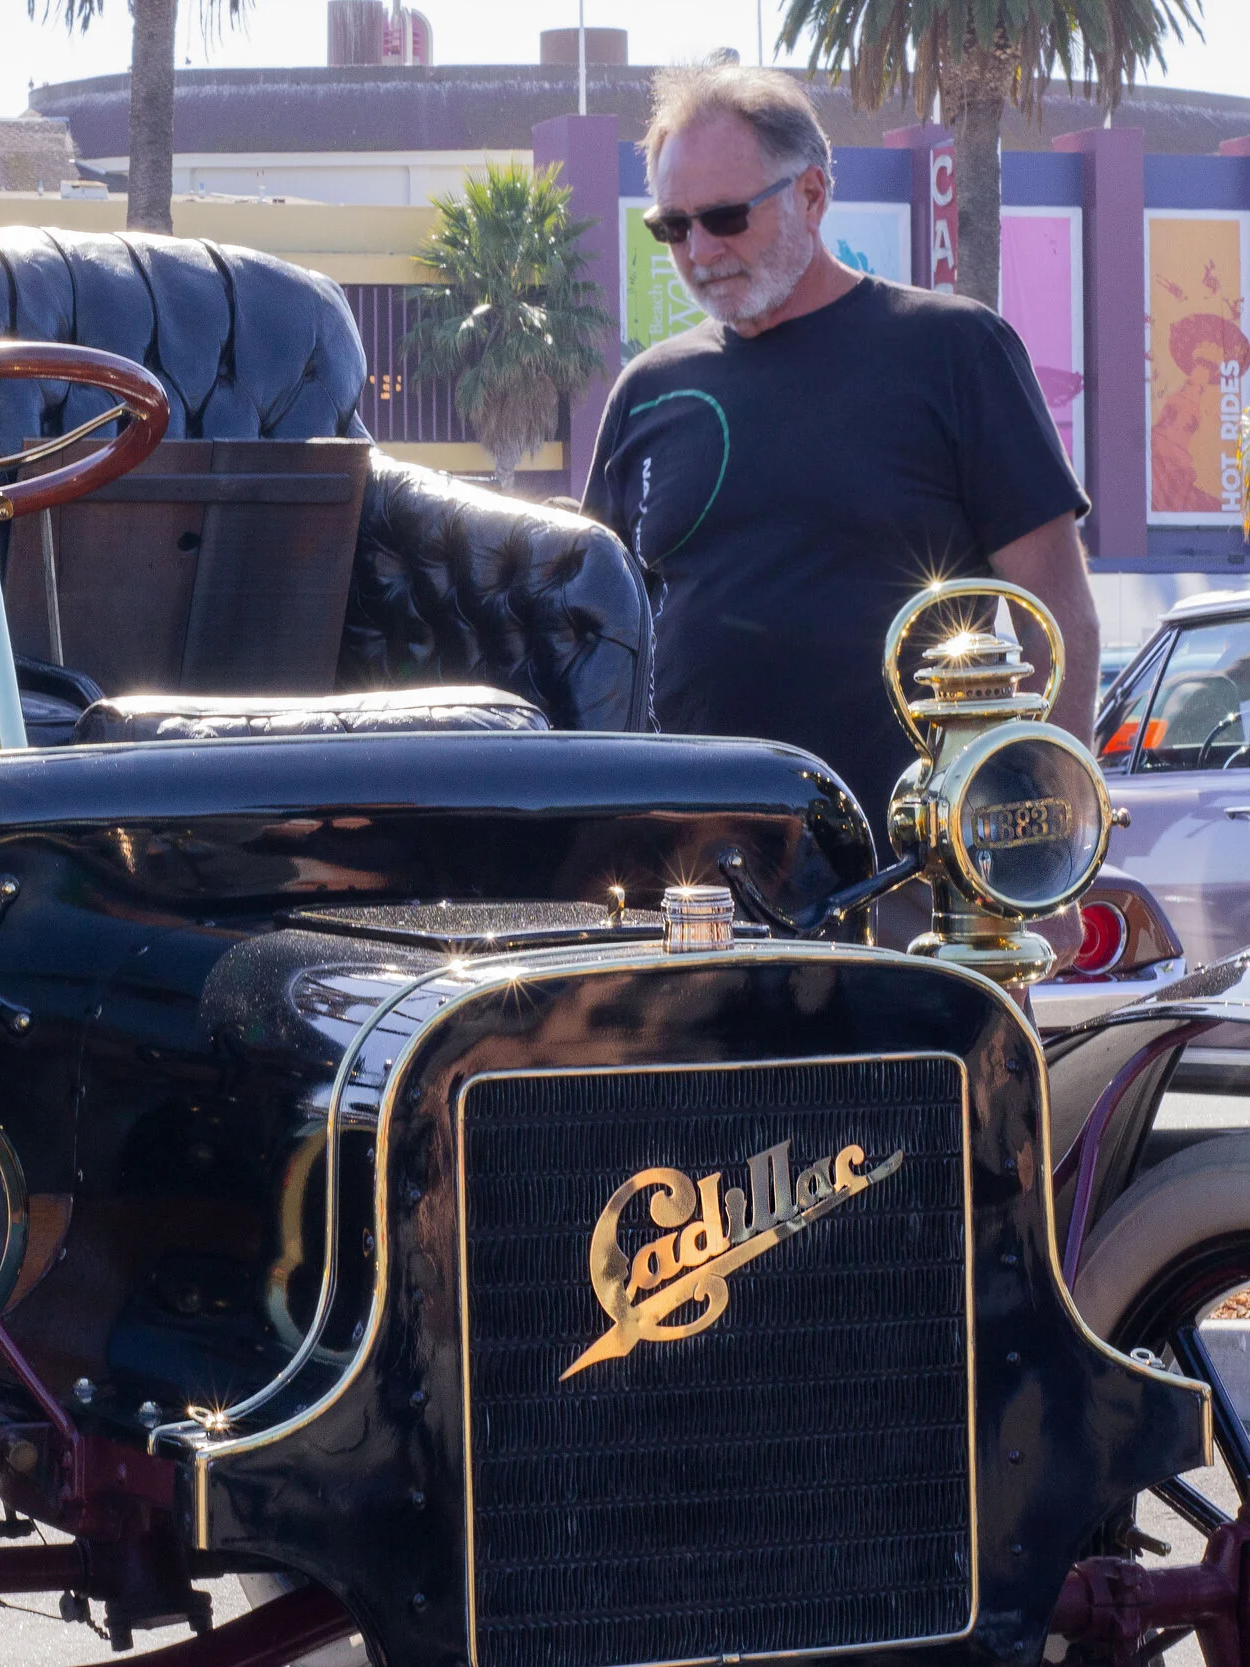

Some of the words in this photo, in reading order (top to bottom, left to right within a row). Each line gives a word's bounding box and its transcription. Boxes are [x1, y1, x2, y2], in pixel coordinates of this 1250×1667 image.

[932, 154, 955, 294] CA
[647, 284, 663, 334] Beach
[1221, 359, 1241, 441] RIDES
[1221, 452, 1241, 512] HOT
[559, 1139, 903, 1382] Cadillac
